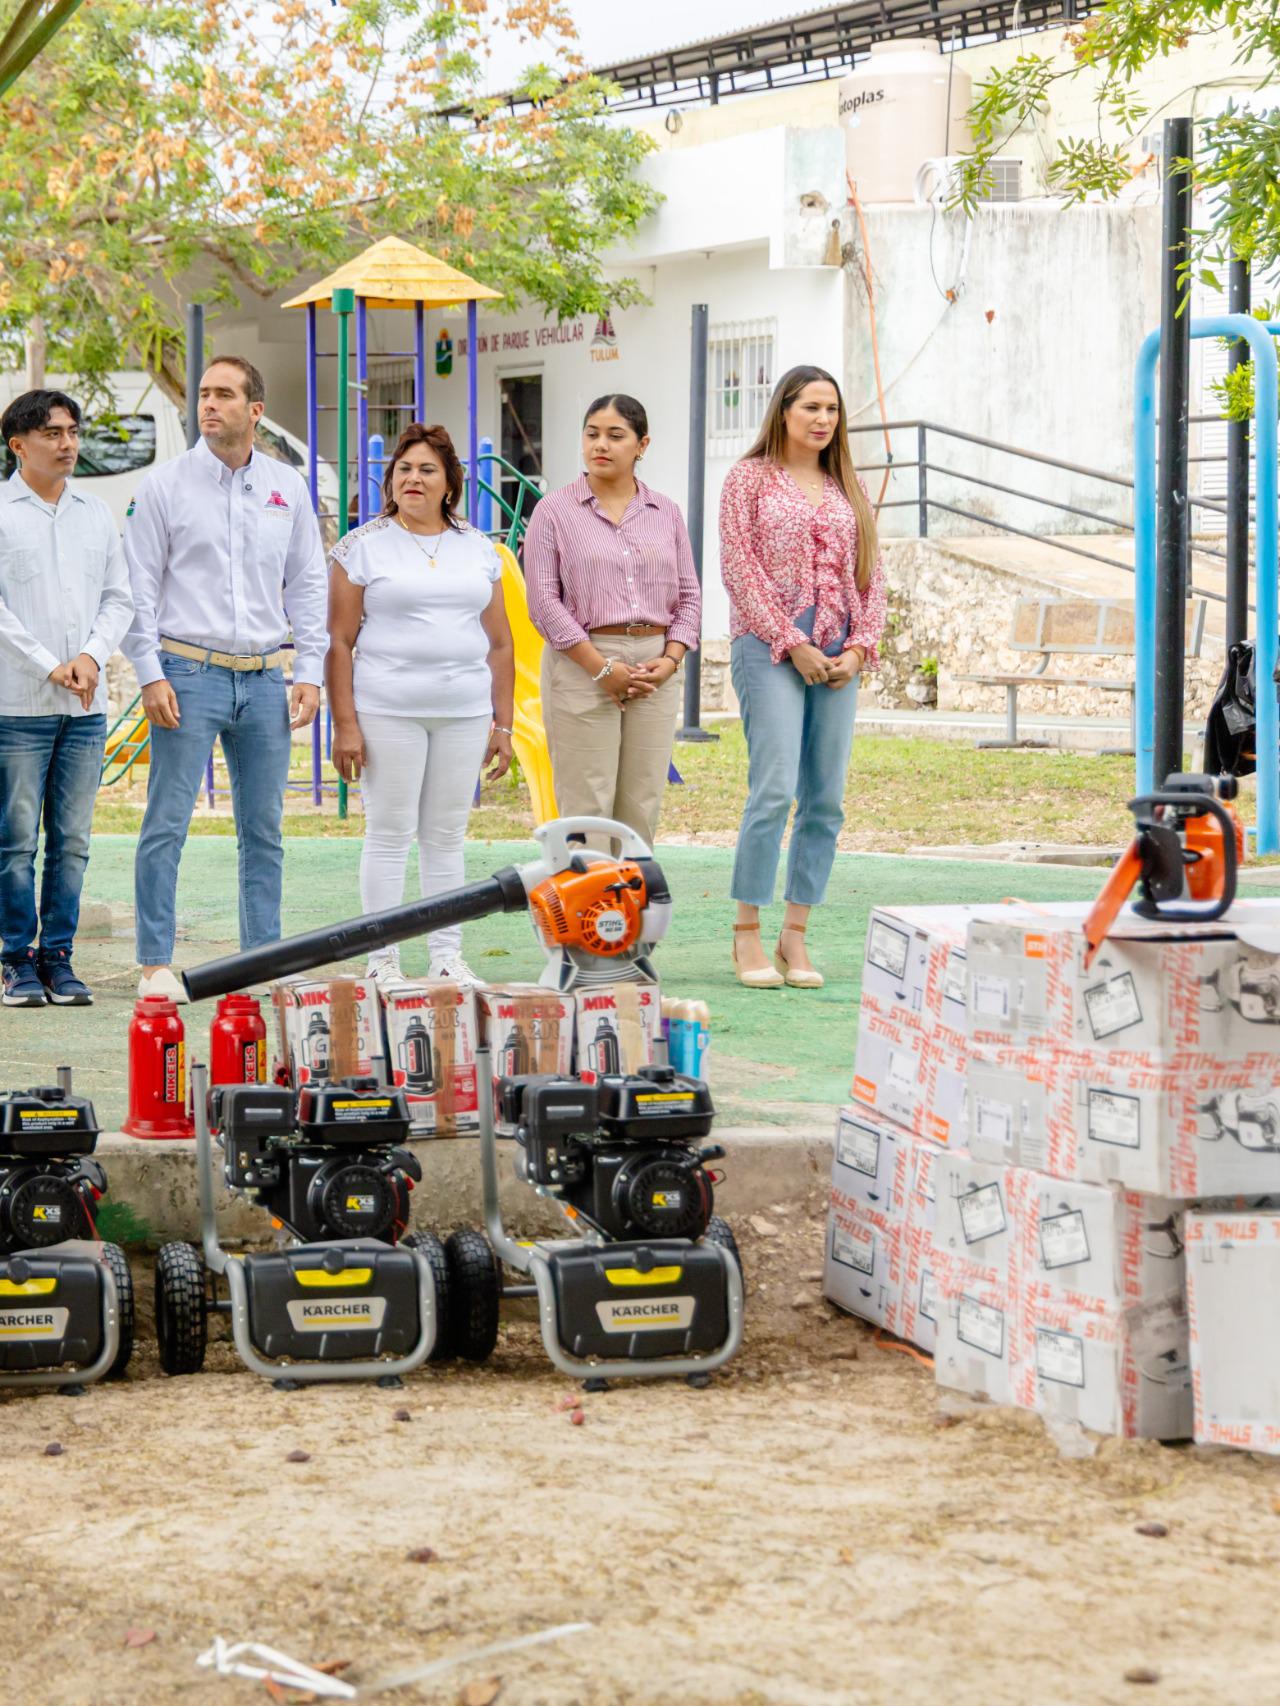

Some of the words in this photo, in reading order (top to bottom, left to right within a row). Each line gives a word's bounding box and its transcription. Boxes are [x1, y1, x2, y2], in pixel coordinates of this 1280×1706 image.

[503, 330, 530, 350] PARQUE
[535, 322, 584, 347] VEHICULAR
[590, 347, 620, 362] TULUM
[868, 1016, 902, 1045] STIHL
[889, 1006, 927, 1034] STIHL
[933, 1023, 967, 1052] STIHL
[1107, 1050, 1153, 1069] STIHL
[1168, 1052, 1226, 1072] STIHL
[1127, 1071, 1180, 1091] STIHL
[1195, 1072, 1255, 1090] STIHL
[1091, 1093, 1115, 1107] STIHL
[835, 1214, 873, 1245] STIHL
[1216, 1221, 1258, 1240] STIHL
[957, 1257, 999, 1284] STIHL
[303, 1303, 371, 1316] KÄRCHER
[611, 1303, 679, 1317] KÄRCHER
[1063, 1289, 1106, 1314] STIHL
[1038, 1332, 1060, 1345] STIHL
[1210, 1423, 1252, 1444] STIHL
